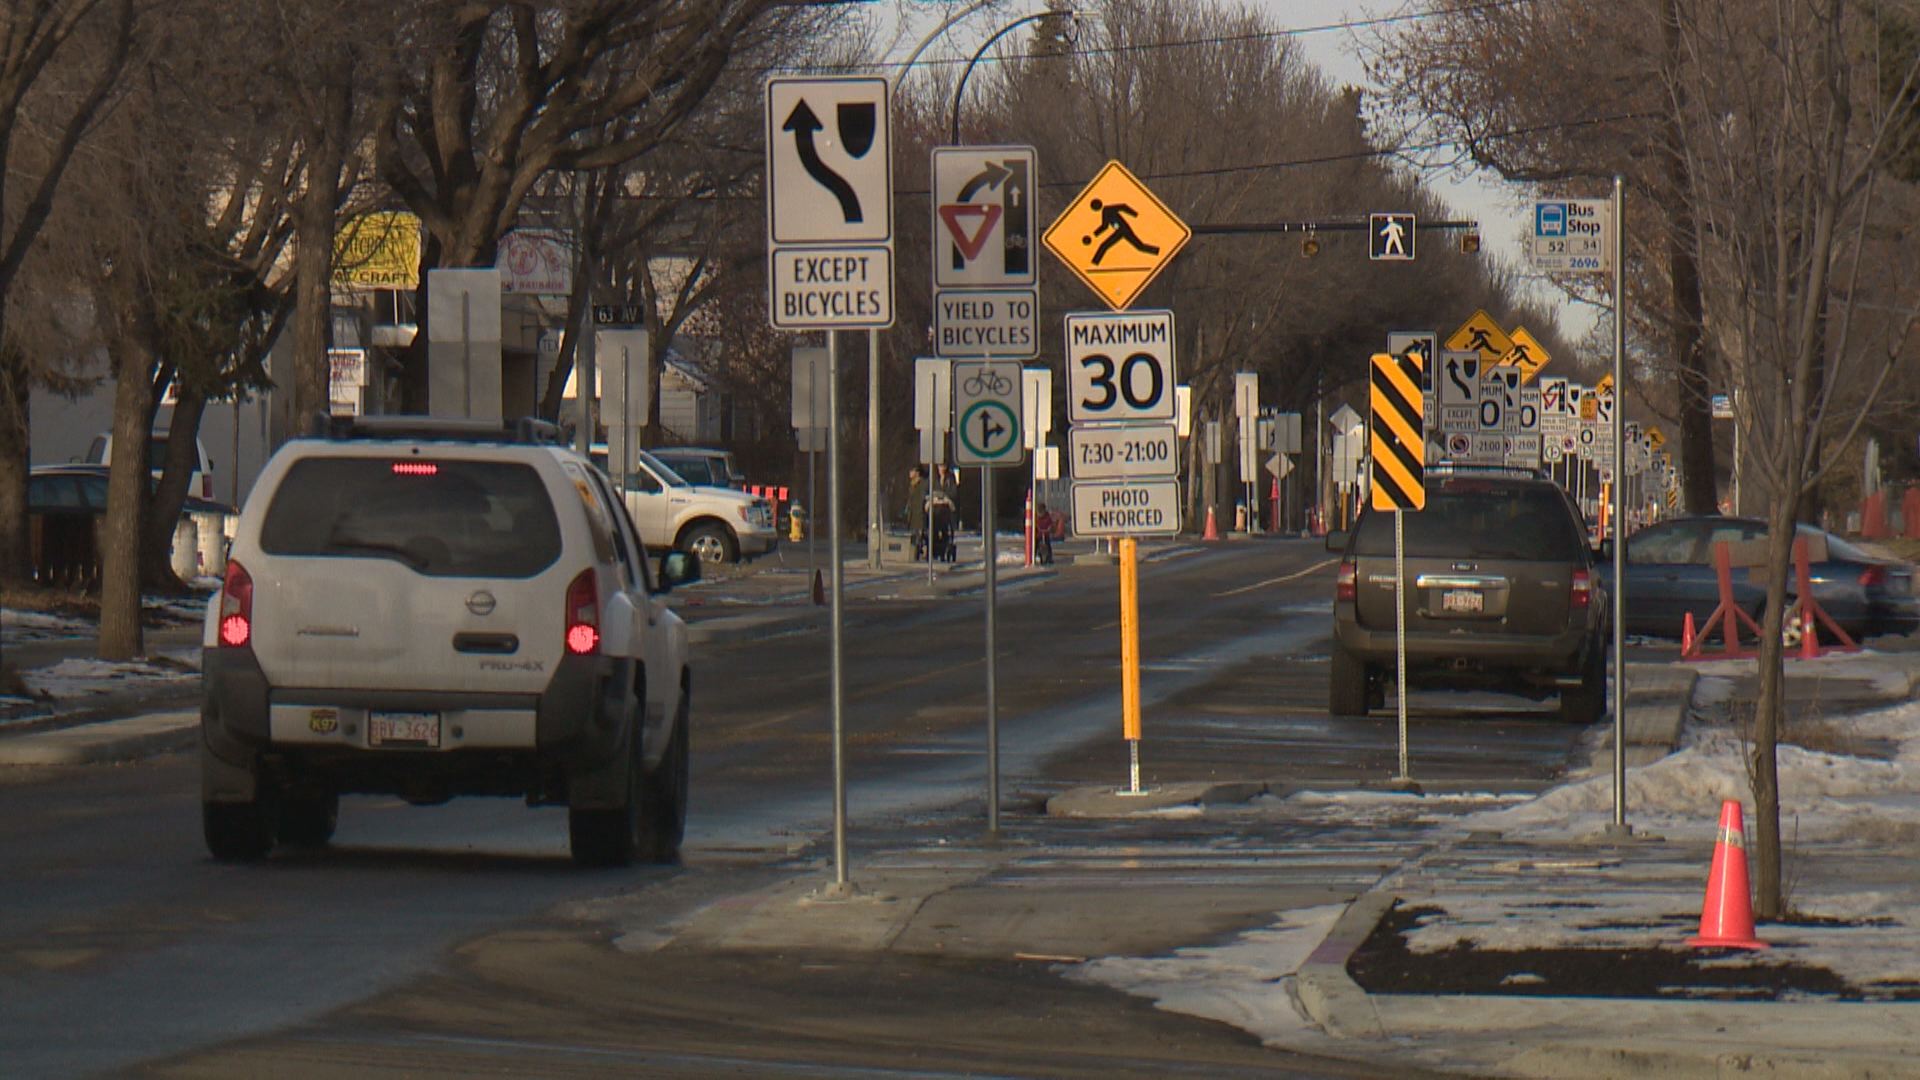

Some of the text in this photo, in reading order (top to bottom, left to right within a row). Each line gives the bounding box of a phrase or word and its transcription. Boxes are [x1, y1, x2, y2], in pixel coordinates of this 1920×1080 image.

[1568, 203, 1594, 216] Bus
[1568, 219, 1600, 236] Stop
[1549, 241, 1564, 252] 52
[794, 257, 868, 283] EXCEPT
[1570, 257, 1599, 268] 2696
[360, 271, 409, 284] CRAFT
[784, 290, 880, 317] BICYCLES
[943, 300, 1030, 321] YIELD TO
[622, 306, 637, 321] AV
[943, 325, 1030, 346] BICYCLES
[1074, 322, 1166, 345] MAXIMUM
[1081, 352, 1164, 412] 30
[1102, 489, 1149, 508] PHOTO
[1090, 508, 1163, 528] ENFORCED
